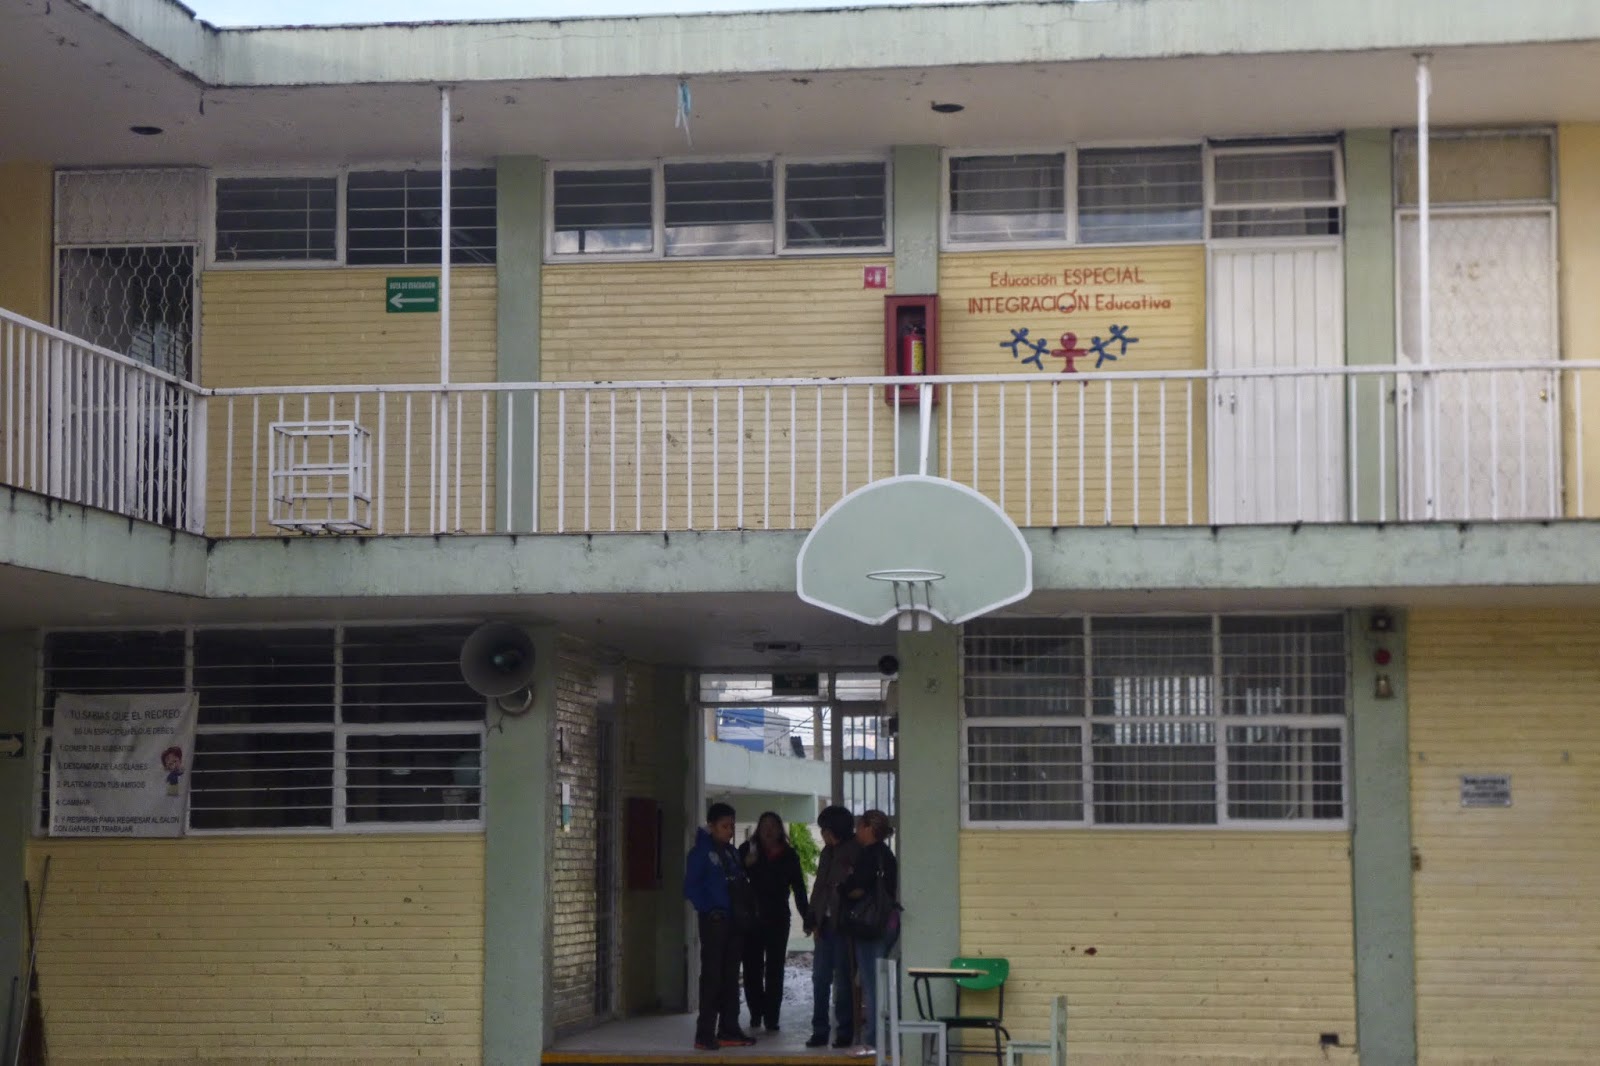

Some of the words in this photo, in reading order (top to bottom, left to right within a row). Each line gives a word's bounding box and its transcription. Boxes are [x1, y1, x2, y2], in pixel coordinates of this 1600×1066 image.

[990, 271, 1057, 288] Educación
[1063, 267, 1144, 286] ESPECIAL
[968, 289, 1089, 314] INTEGRACIÓN
[1095, 293, 1171, 312] Educativa
[112, 711, 130, 722] QUE
[131, 711, 142, 721] EL
[138, 727, 151, 735] QUE
[63, 780, 92, 789] PLATICAR
[92, 780, 106, 789] CON
[107, 780, 120, 789] TUS
[120, 780, 146, 789] AMIGOS
[99, 816, 115, 824] PARA
[116, 816, 151, 824] REGRESAR
[53, 825, 68, 833] CON
[68, 825, 90, 833] GANAS
[91, 825, 100, 833] DE
[101, 825, 133, 833] TRABAJAR
